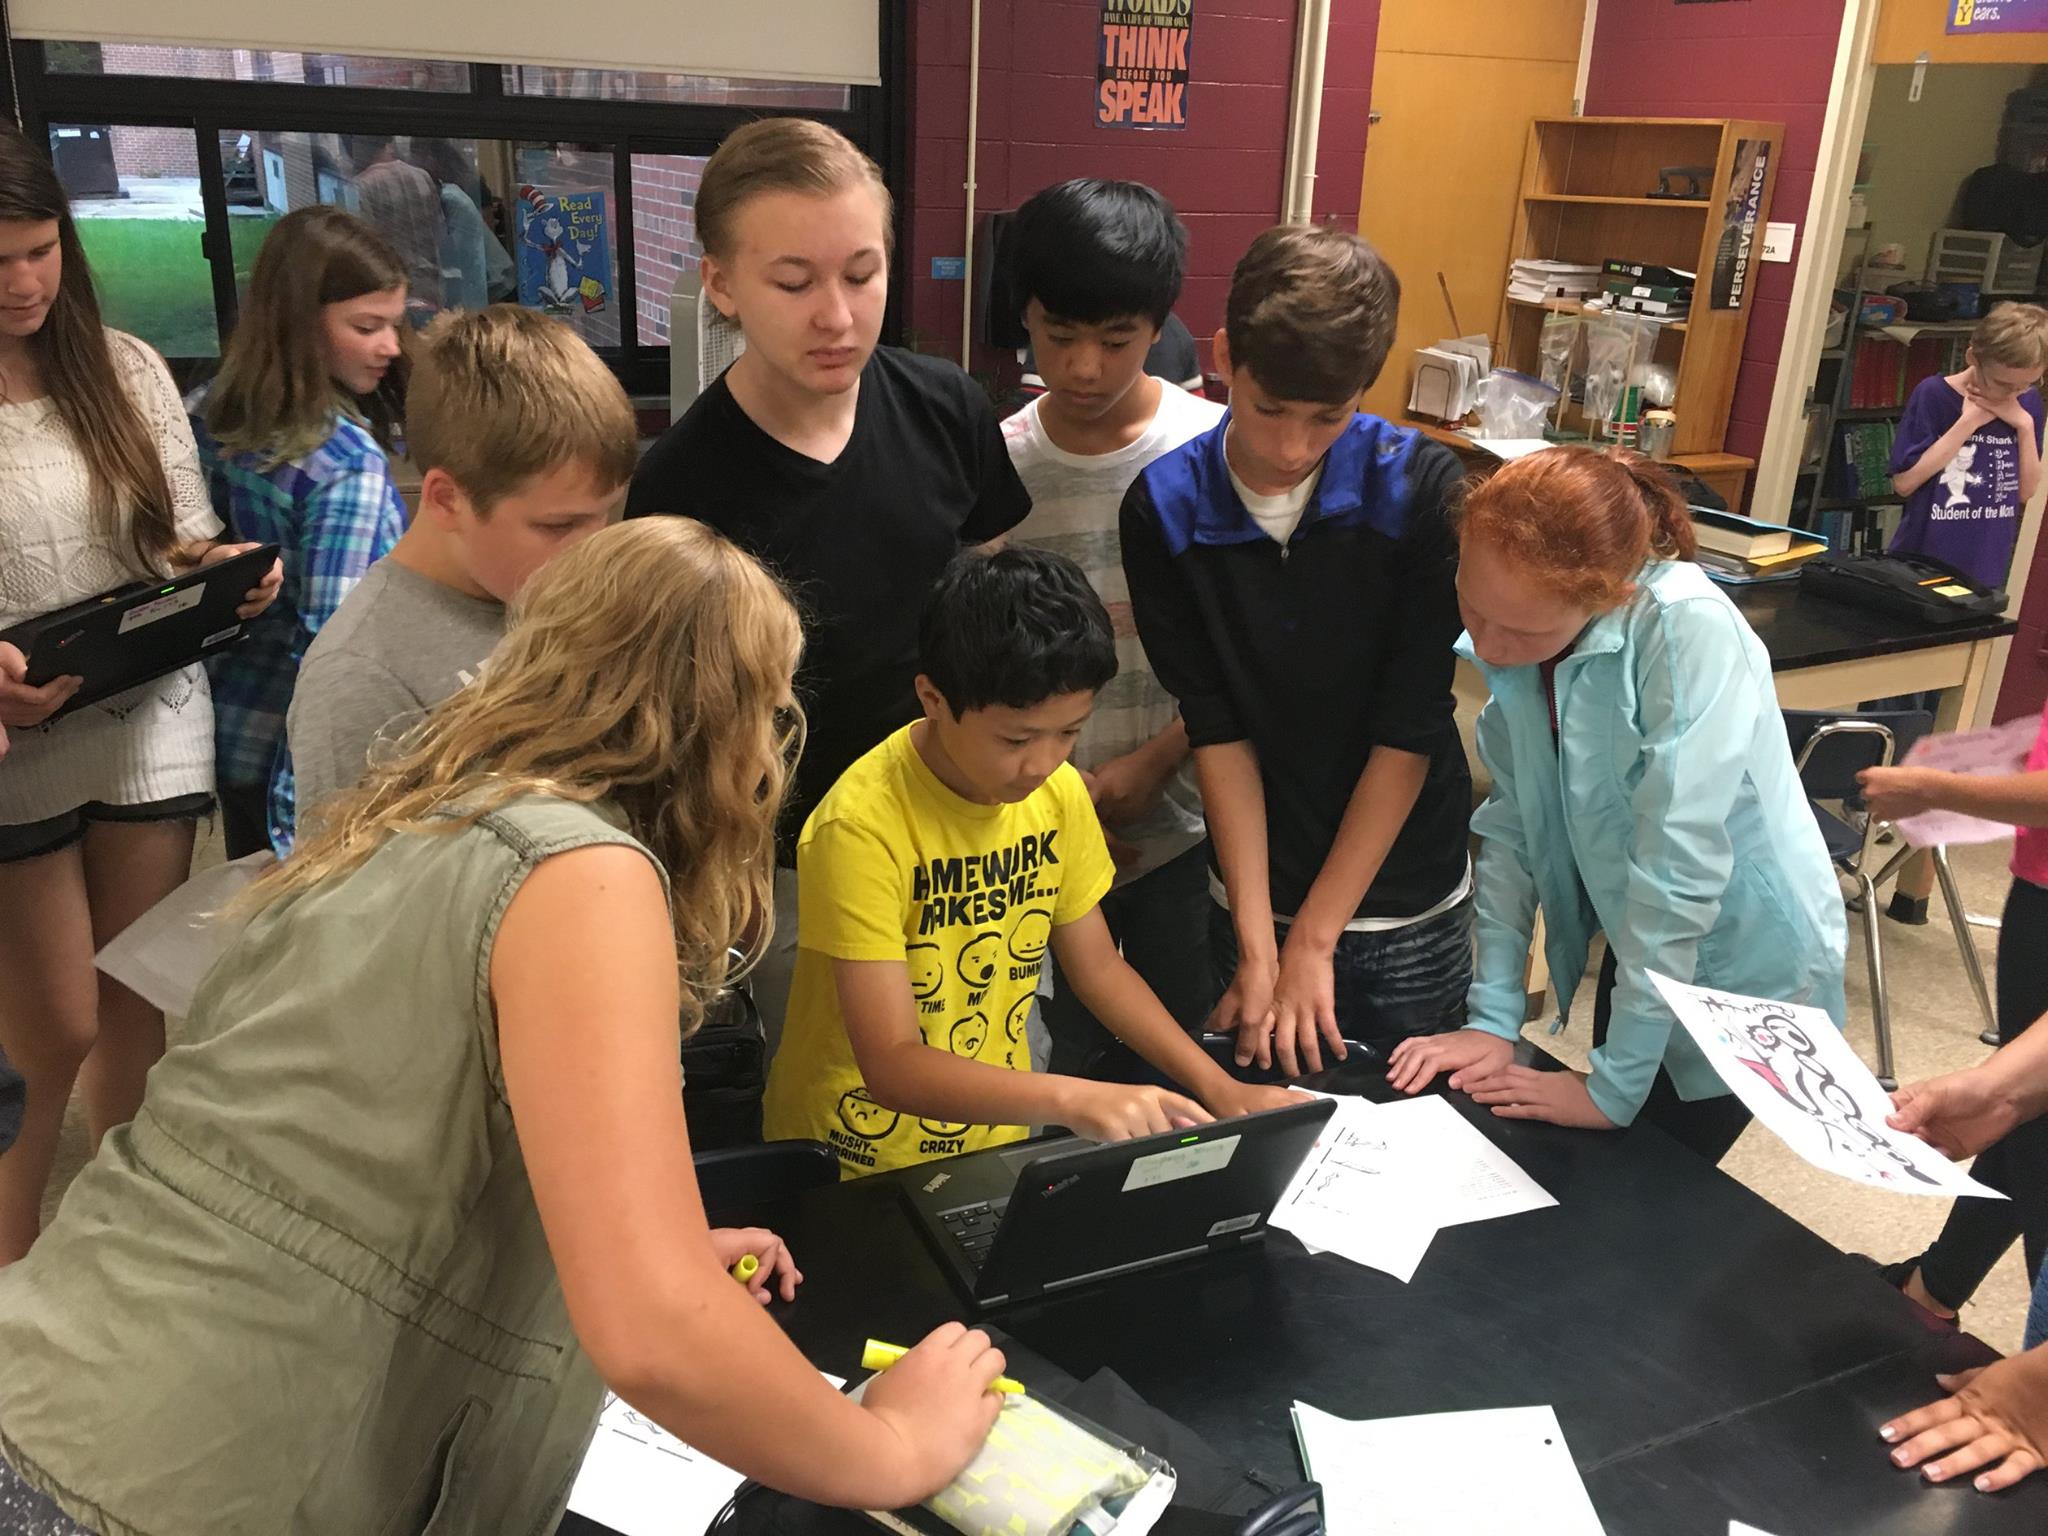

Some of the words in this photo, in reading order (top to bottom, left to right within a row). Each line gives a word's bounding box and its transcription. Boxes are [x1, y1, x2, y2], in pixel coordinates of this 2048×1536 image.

[1103, 24, 1189, 71] THINK
[1116, 69, 1150, 80] BEFORE
[1155, 70, 1172, 81] YOU
[558, 197, 592, 212] Read
[571, 211, 603, 225] Every
[567, 224, 599, 241] Day!
[1729, 155, 1766, 308] PERSEVERANCE
[1986, 435, 2012, 445] Shark
[1931, 503, 1970, 520] Student
[1971, 506, 1983, 519] of
[1984, 506, 1998, 519] the
[829, 1129, 878, 1154] MUSHY-
[919, 1139, 965, 1154] CRAZY
